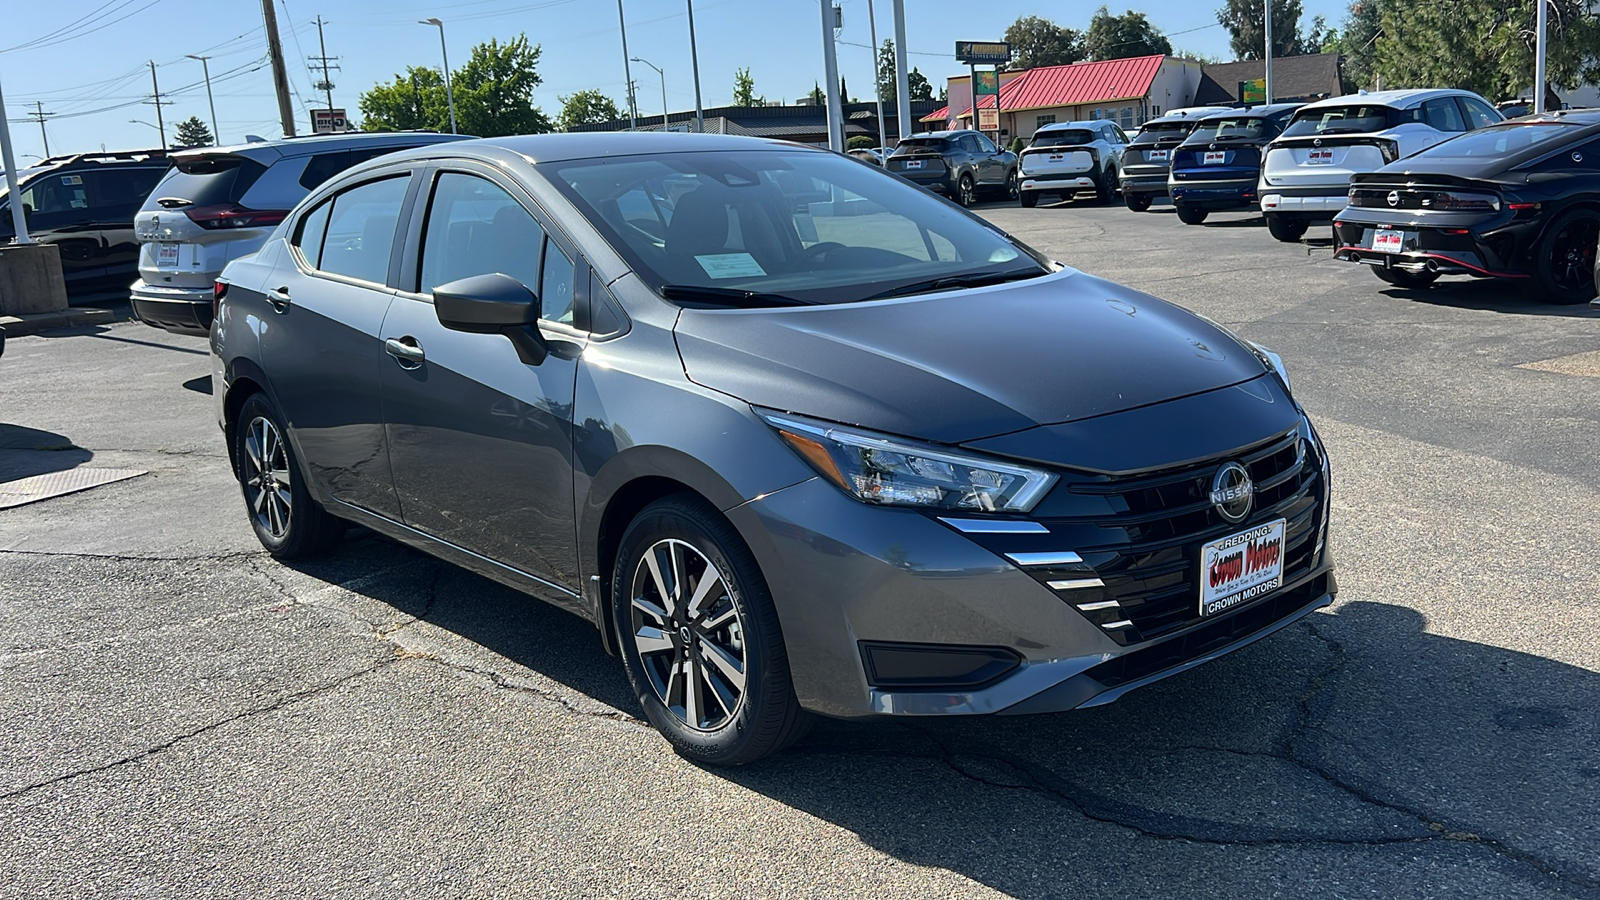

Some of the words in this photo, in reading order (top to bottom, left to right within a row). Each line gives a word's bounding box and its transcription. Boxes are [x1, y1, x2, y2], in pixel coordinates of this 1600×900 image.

[1211, 482, 1251, 504] NISSAN
[1224, 526, 1269, 548] REDDING
[1209, 550, 1243, 588] Crown
[1245, 537, 1281, 575] Motors
[1208, 593, 1241, 613] CROWN
[1242, 578, 1279, 600] MOTORS
